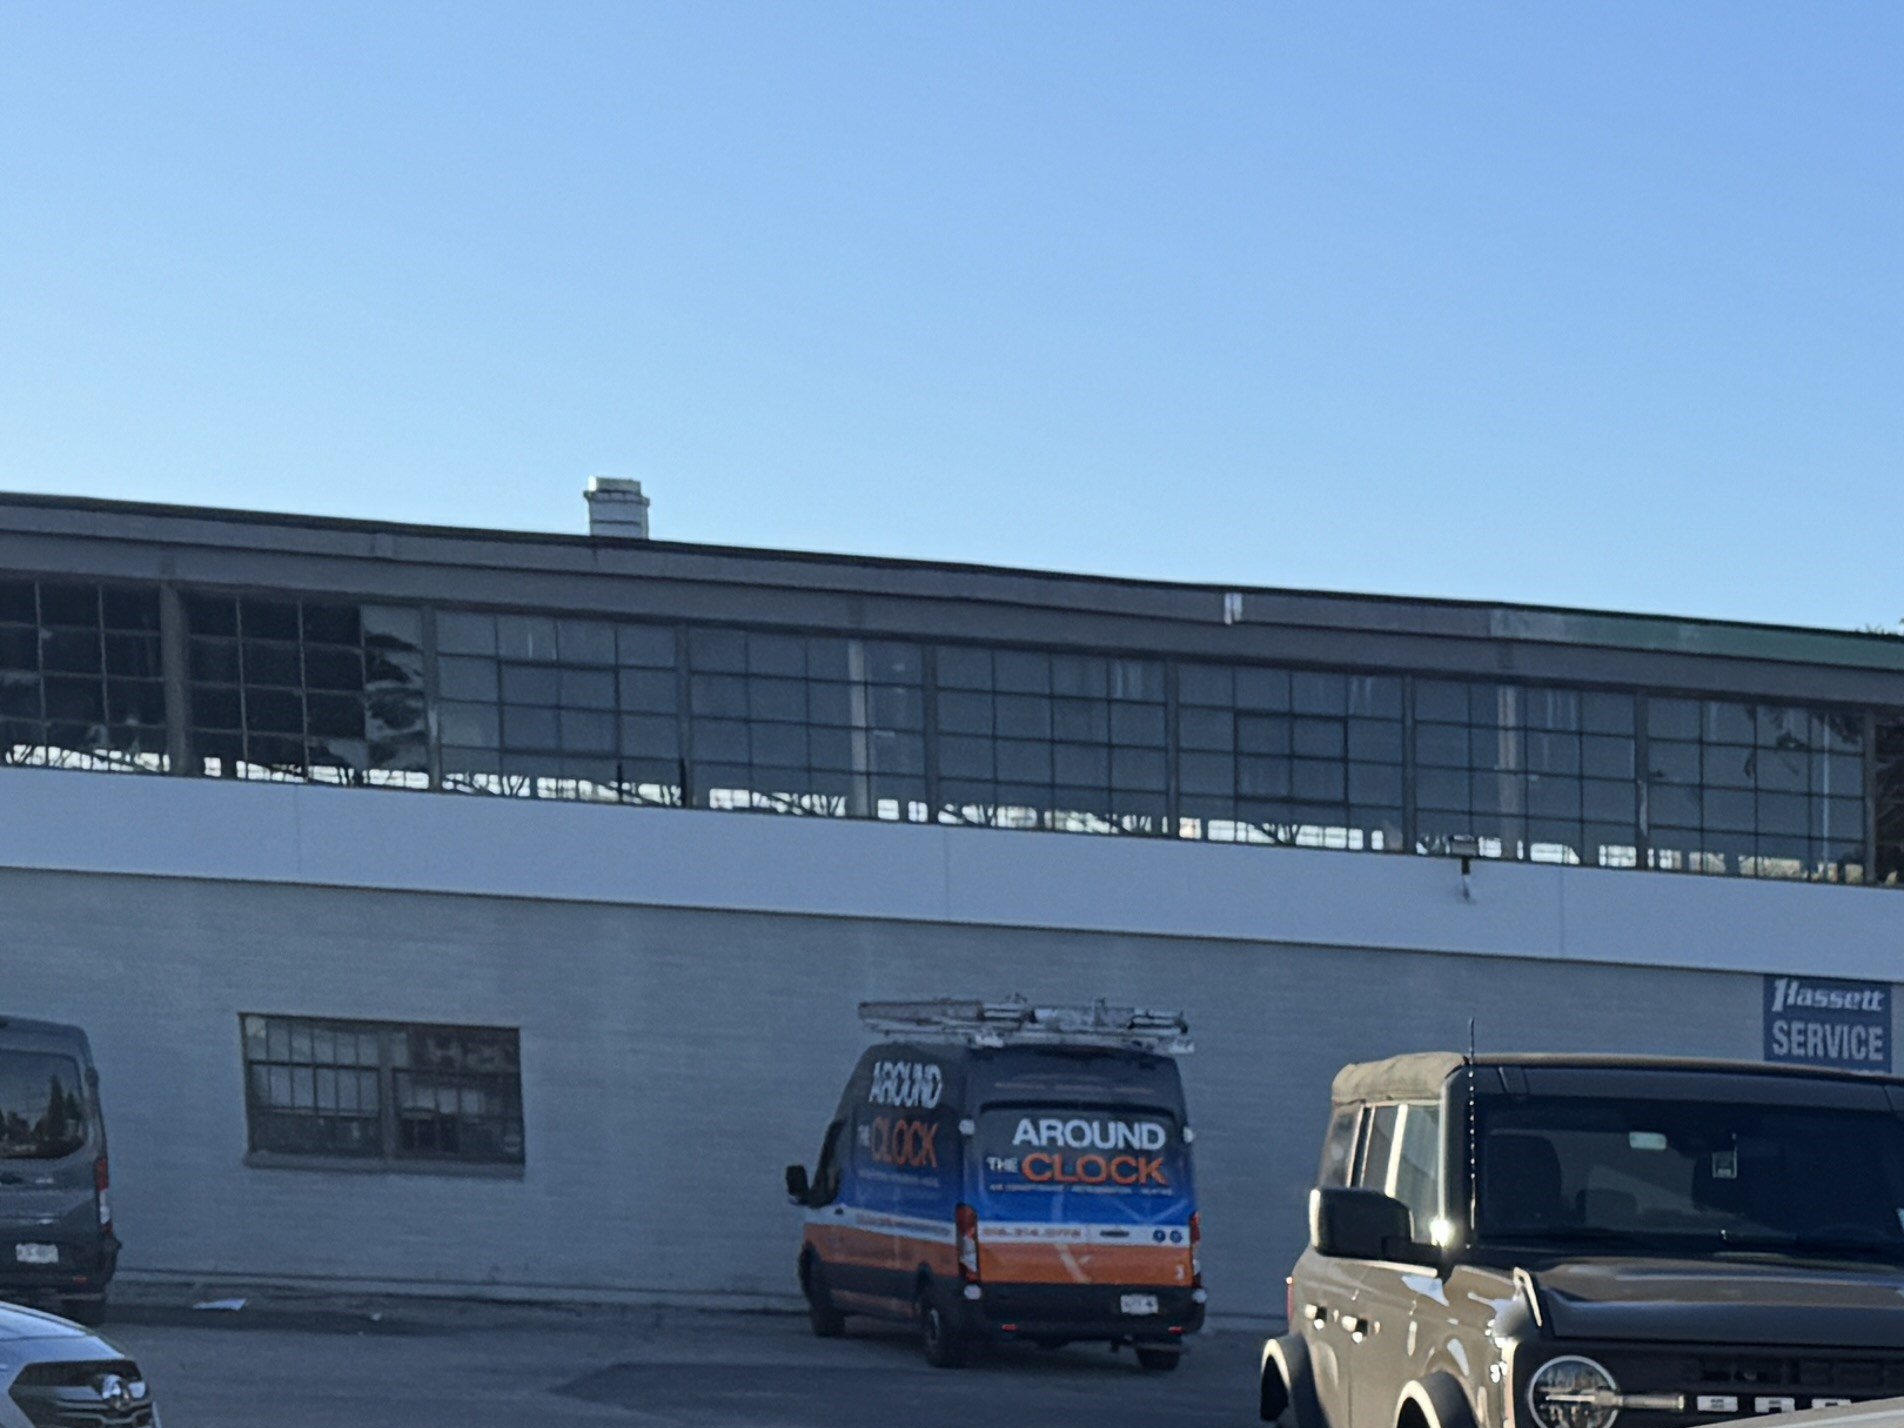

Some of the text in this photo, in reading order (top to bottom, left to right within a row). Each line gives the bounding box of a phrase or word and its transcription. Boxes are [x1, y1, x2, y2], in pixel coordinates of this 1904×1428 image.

[1771, 978, 1885, 1012] Hassett
[1772, 1020, 1884, 1061] SERVICE
[869, 1061, 943, 1109] AROUND
[872, 1116, 940, 1168] CLOCK
[1012, 1118, 1167, 1150] AROUND
[986, 1152, 1169, 1185] THE CLOCK
